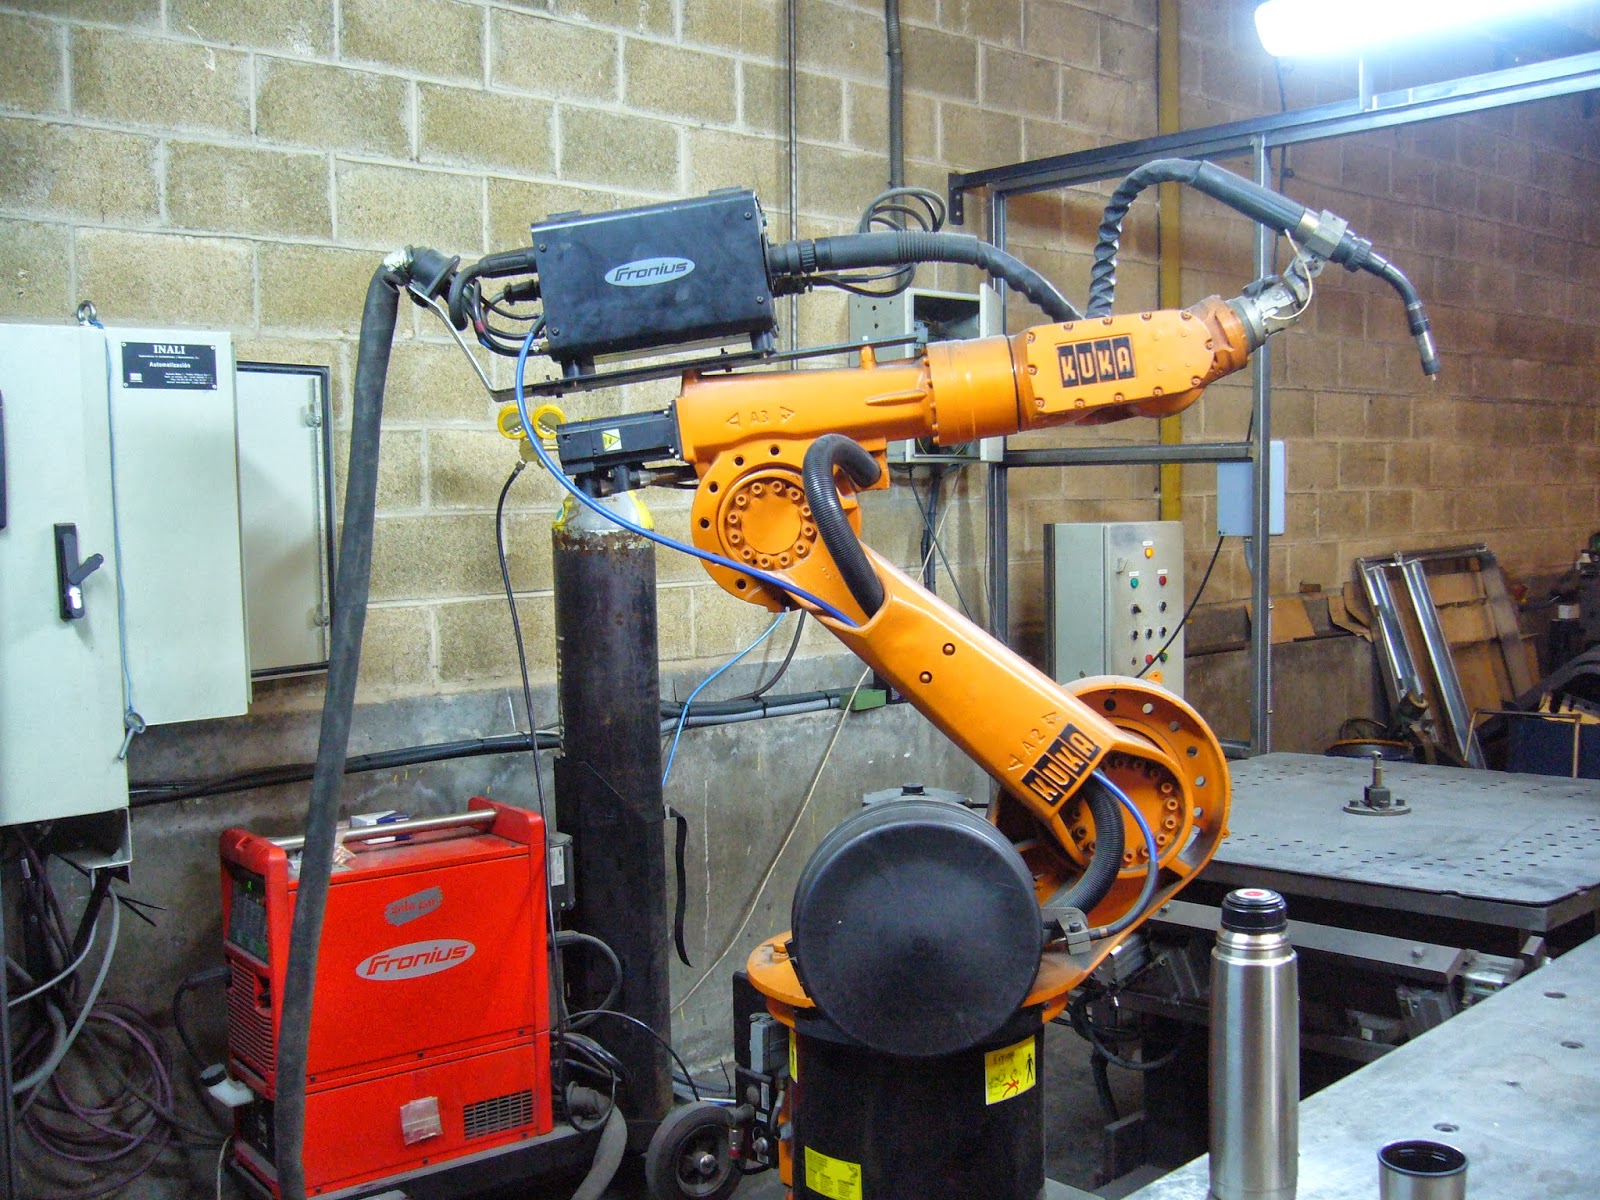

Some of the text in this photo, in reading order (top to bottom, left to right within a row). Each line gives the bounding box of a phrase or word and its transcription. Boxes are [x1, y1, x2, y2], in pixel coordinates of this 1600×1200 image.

[614, 262, 688, 282] Fronius
[153, 344, 186, 355] INALI
[149, 361, 192, 369] Automatización
[1059, 344, 1132, 382] KUKA
[750, 410, 769, 425] A3
[1021, 728, 1046, 757] A2
[1028, 731, 1099, 802] KUKA
[366, 944, 469, 976] Fronius
